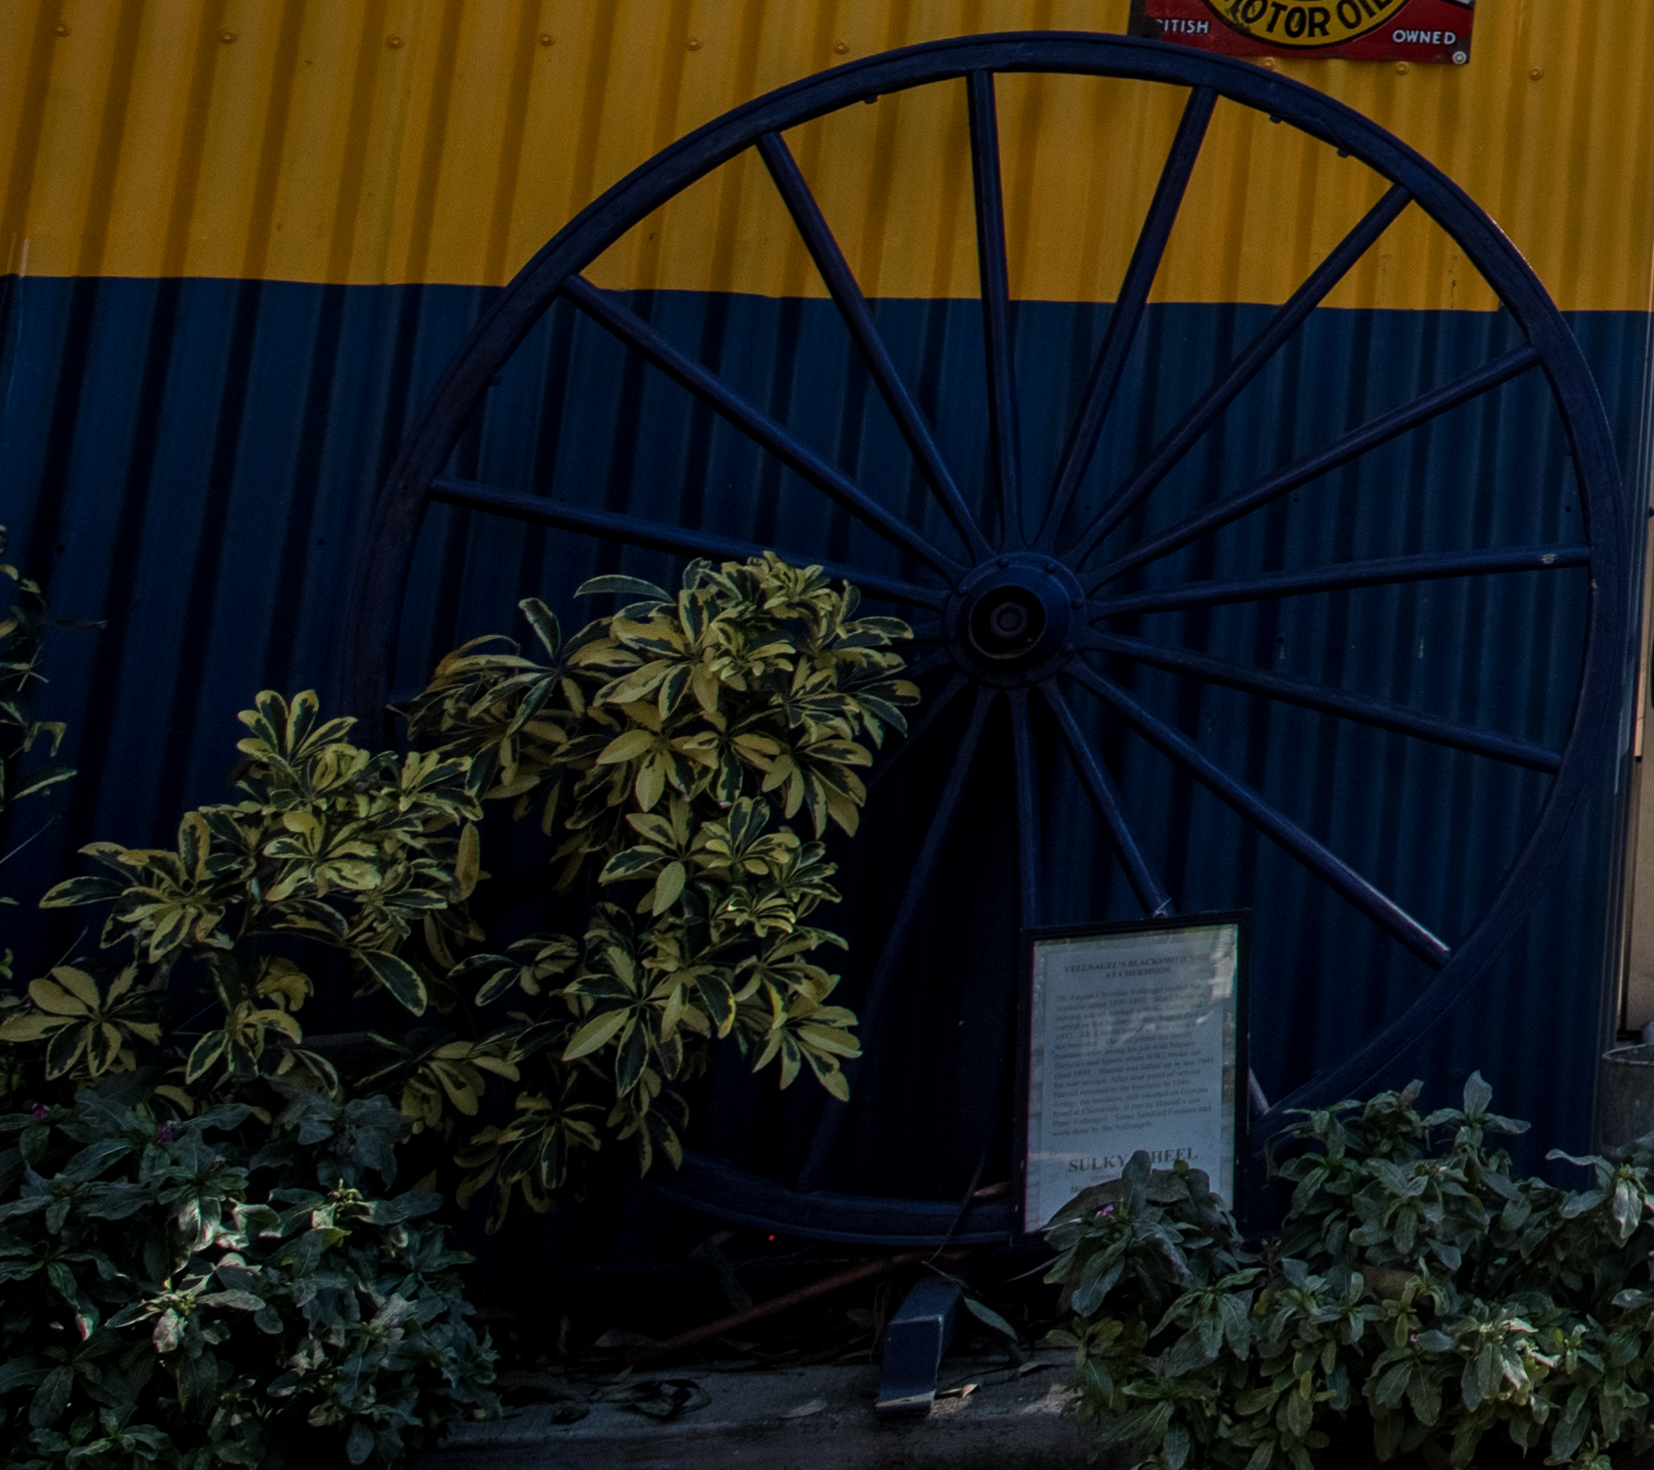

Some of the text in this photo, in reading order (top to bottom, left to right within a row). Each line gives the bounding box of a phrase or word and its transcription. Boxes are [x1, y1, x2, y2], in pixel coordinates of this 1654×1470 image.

[1155, 18, 1209, 34] ITISH
[1392, 29, 1456, 45] OWNED
[1068, 1147, 1198, 1172] SULKY HEEL
